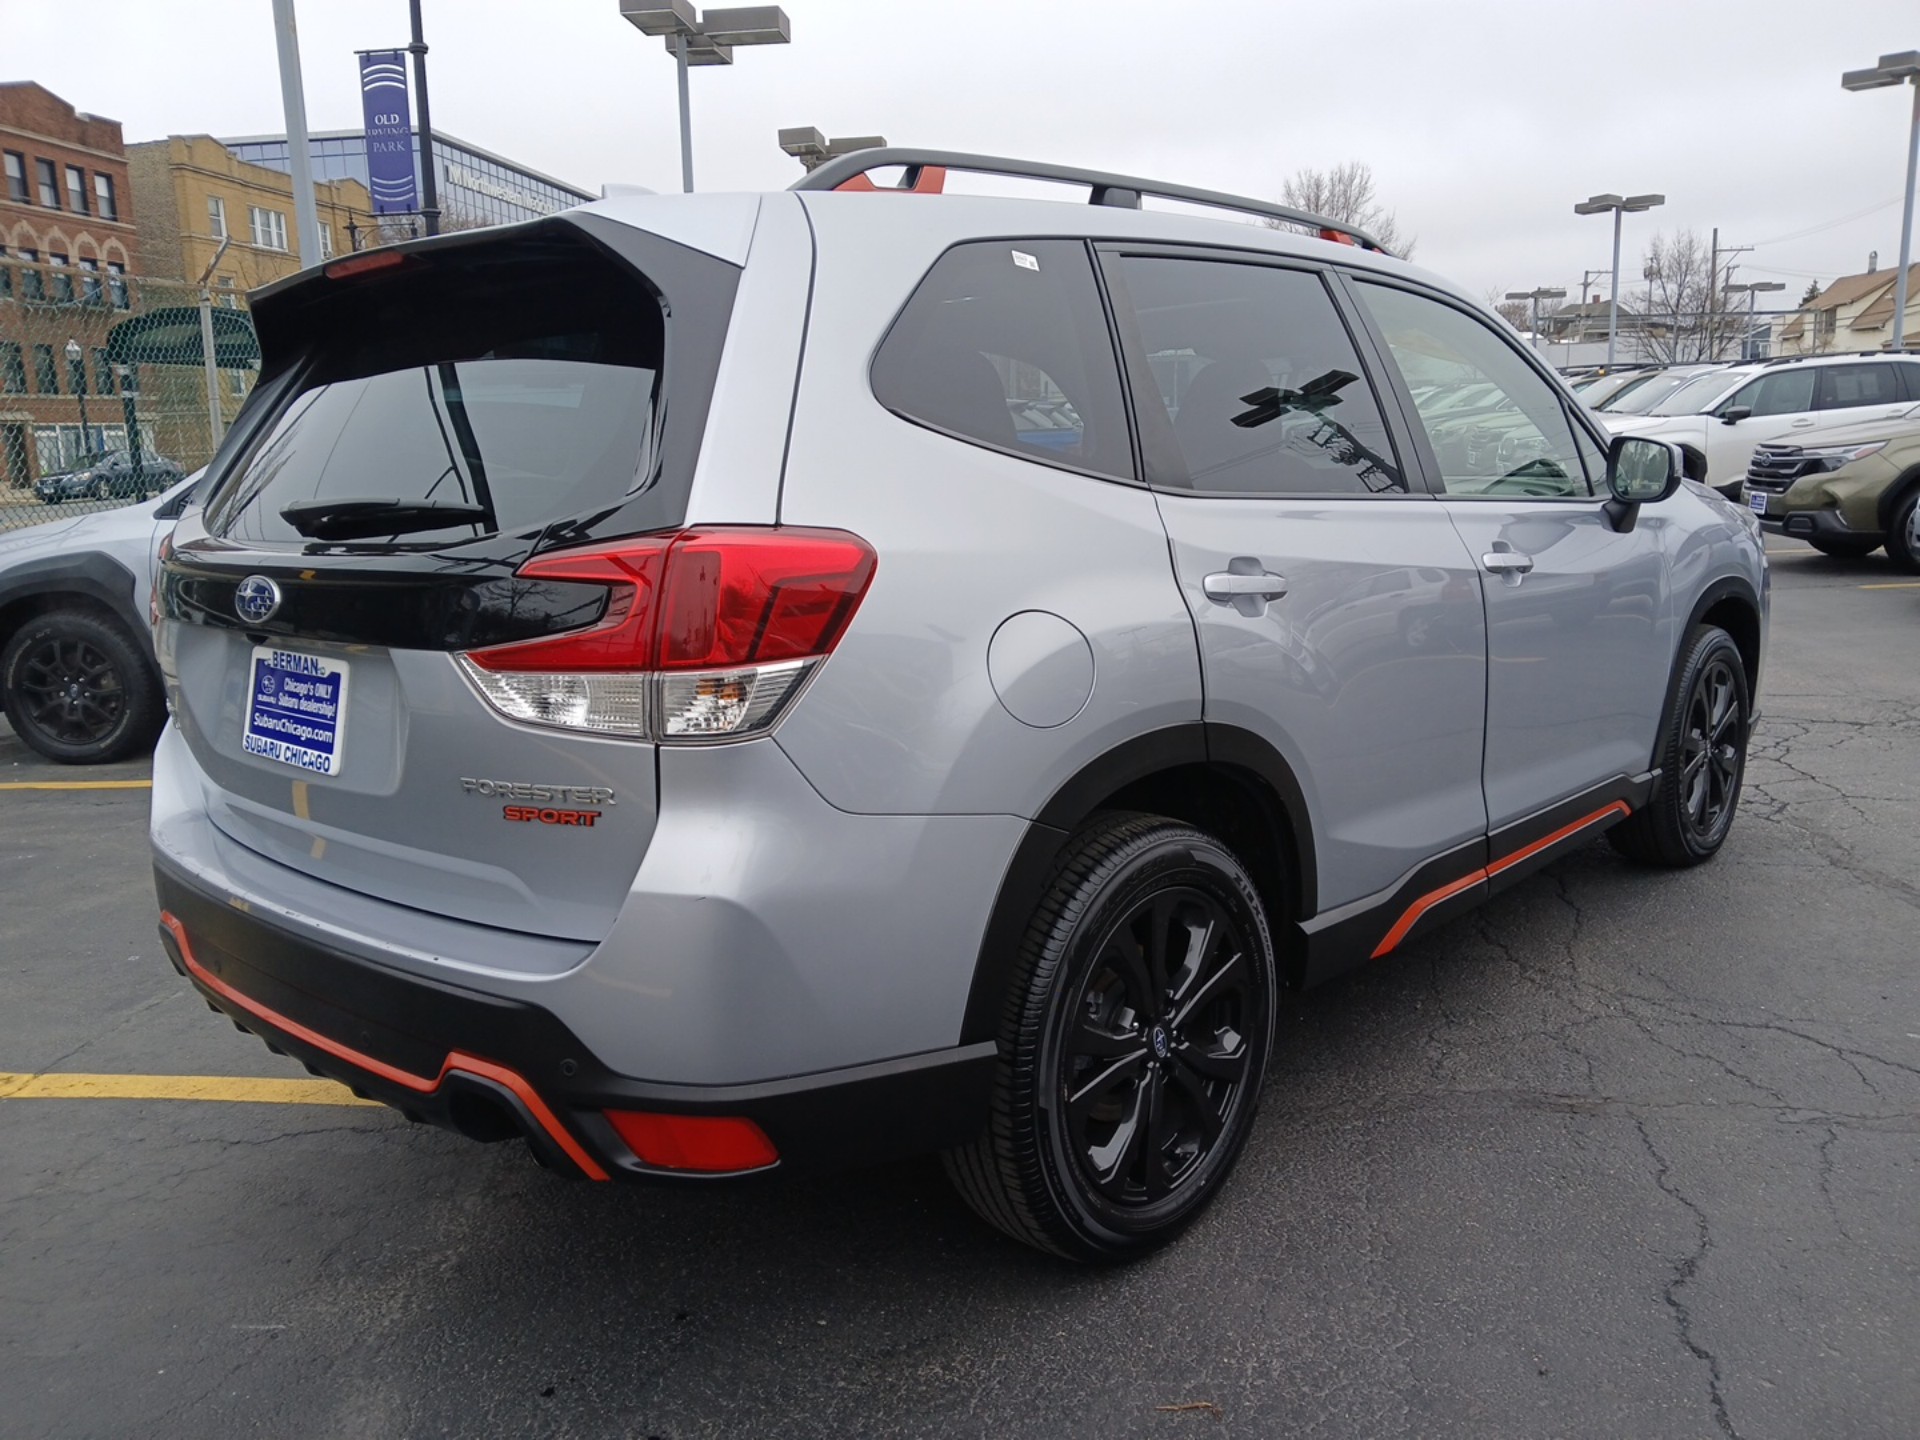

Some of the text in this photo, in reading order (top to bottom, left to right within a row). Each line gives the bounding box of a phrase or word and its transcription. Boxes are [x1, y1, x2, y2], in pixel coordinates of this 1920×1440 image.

[374, 114, 400, 125] OLD
[373, 141, 406, 152] PARK
[462, 171, 522, 202] Northwestern
[272, 651, 319, 675] BERMAN
[284, 677, 333, 699] Chicago's ONLY
[278, 693, 336, 719] Subaru dealership!
[253, 712, 333, 743] SubaruChicago.com
[244, 734, 331, 773] SUBARU CHICAGO
[460, 777, 617, 805] FORESTER
[503, 805, 602, 827] SPORT
